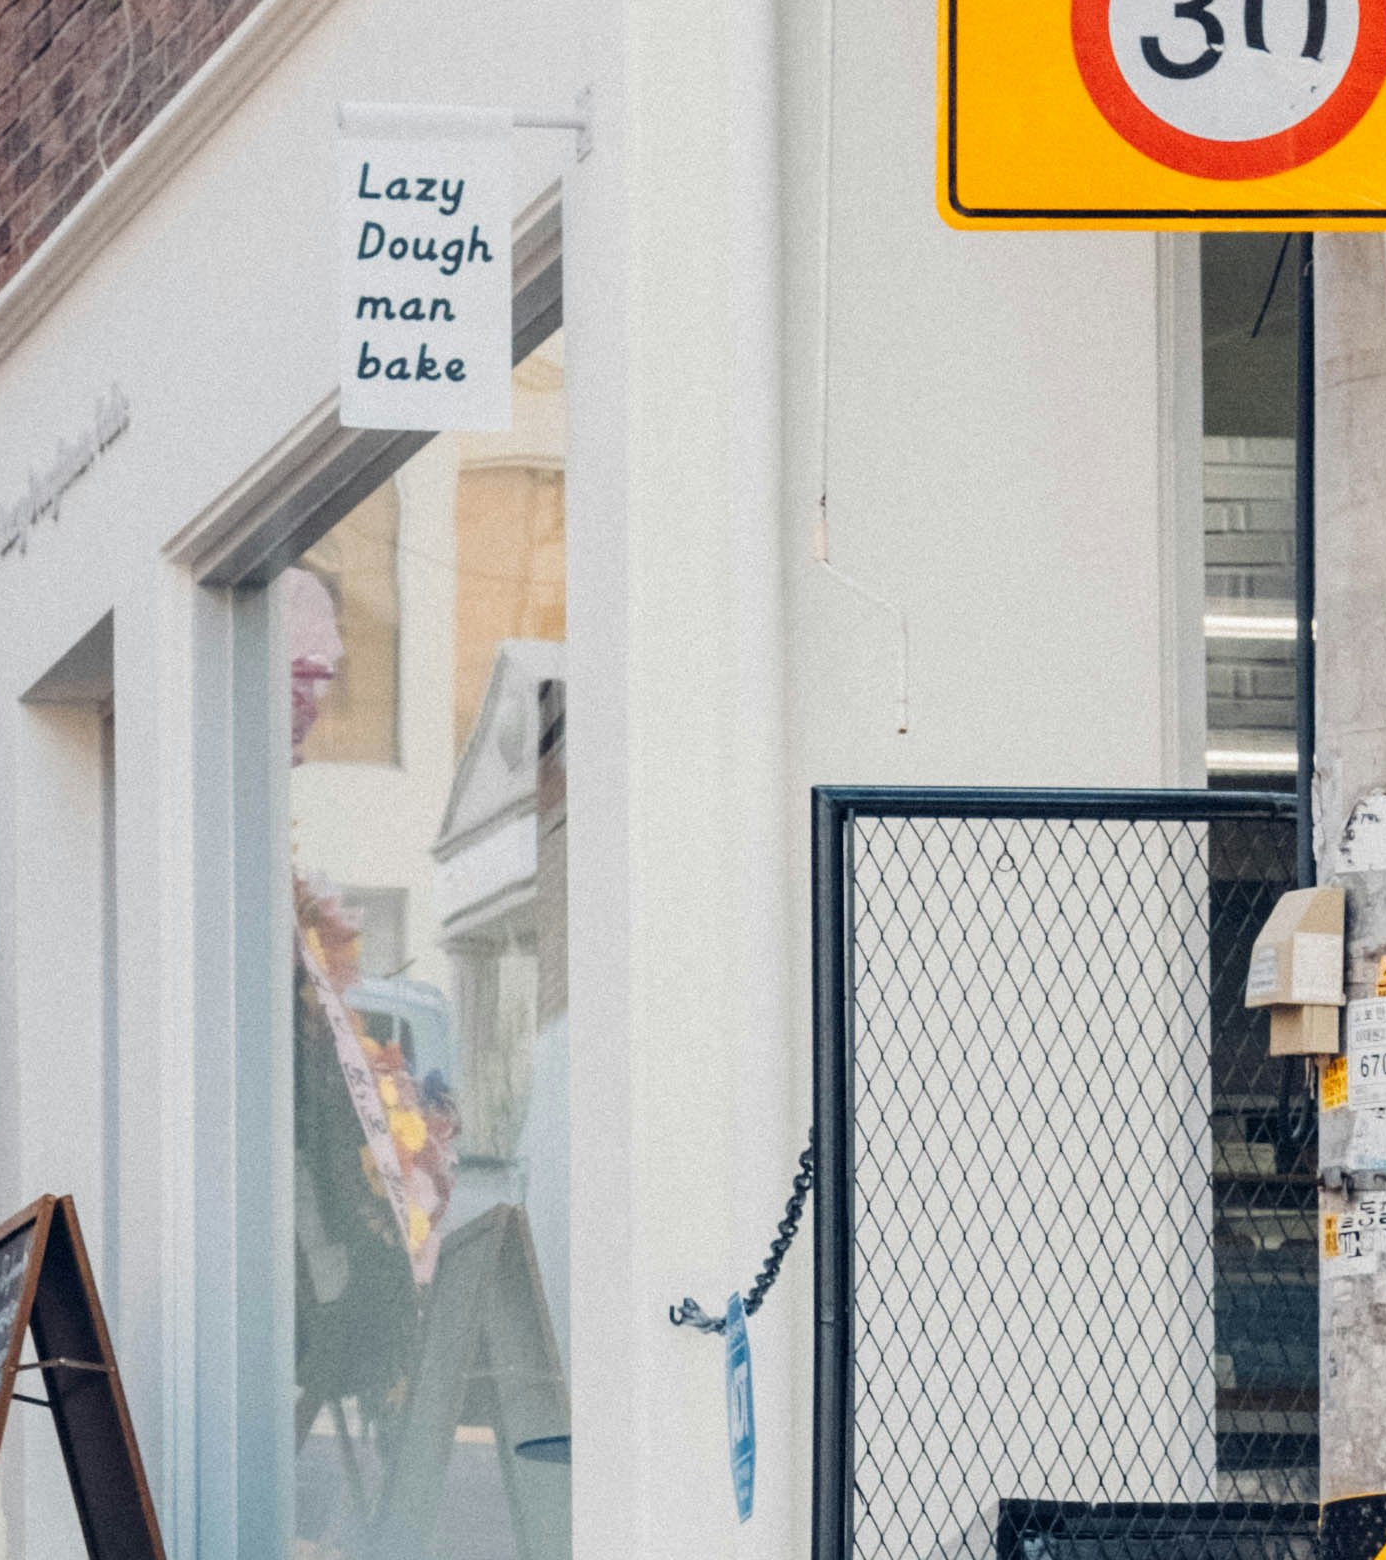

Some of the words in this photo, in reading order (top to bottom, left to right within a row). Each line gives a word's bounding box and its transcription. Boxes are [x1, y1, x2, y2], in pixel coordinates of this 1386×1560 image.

[358, 162, 465, 215] Lazy
[356, 221, 494, 276] Dough
[355, 295, 456, 322] man
[356, 341, 468, 383] bake
